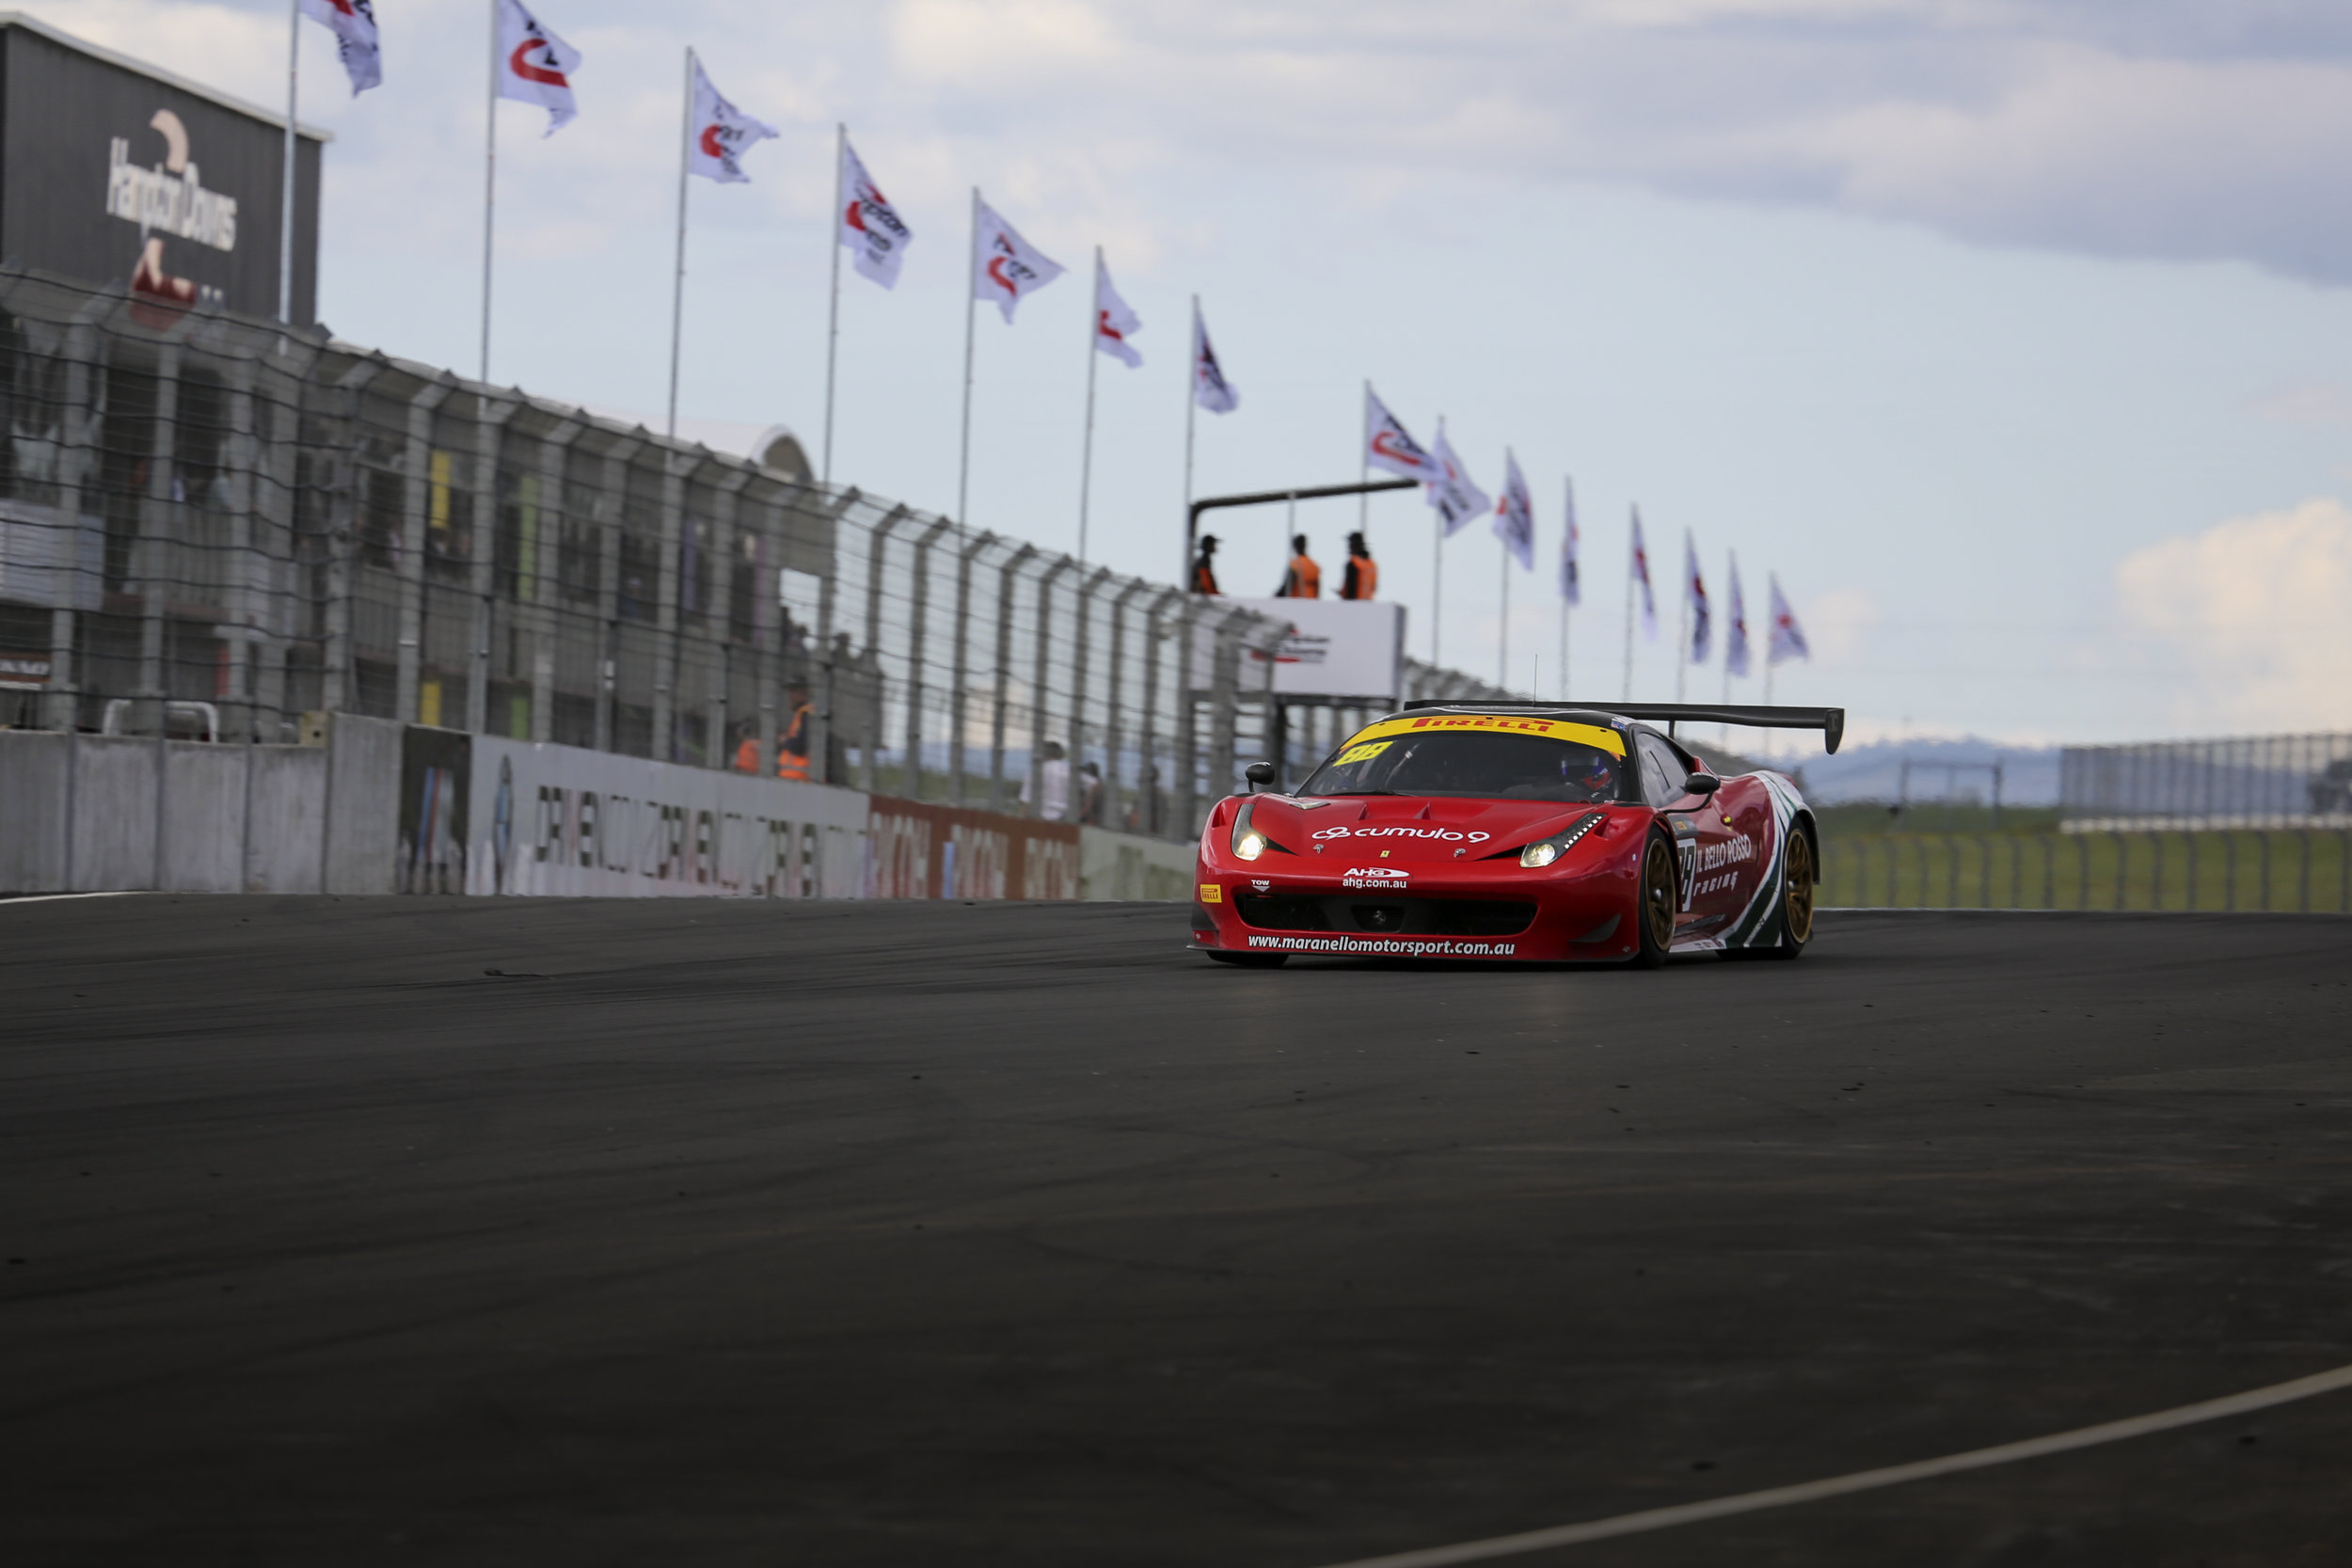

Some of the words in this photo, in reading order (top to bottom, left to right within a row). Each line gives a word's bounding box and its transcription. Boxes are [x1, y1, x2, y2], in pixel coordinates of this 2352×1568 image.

[1411, 714, 1555, 733] PIRELLI
[1704, 842, 1726, 871] BELLO
[1727, 834, 1751, 863] ROSSO
[1343, 867, 1387, 877] AHG
[1343, 877, 1407, 889] ahg.com.au
[1248, 935, 1515, 957] www.maranellomotorsport.com.au
